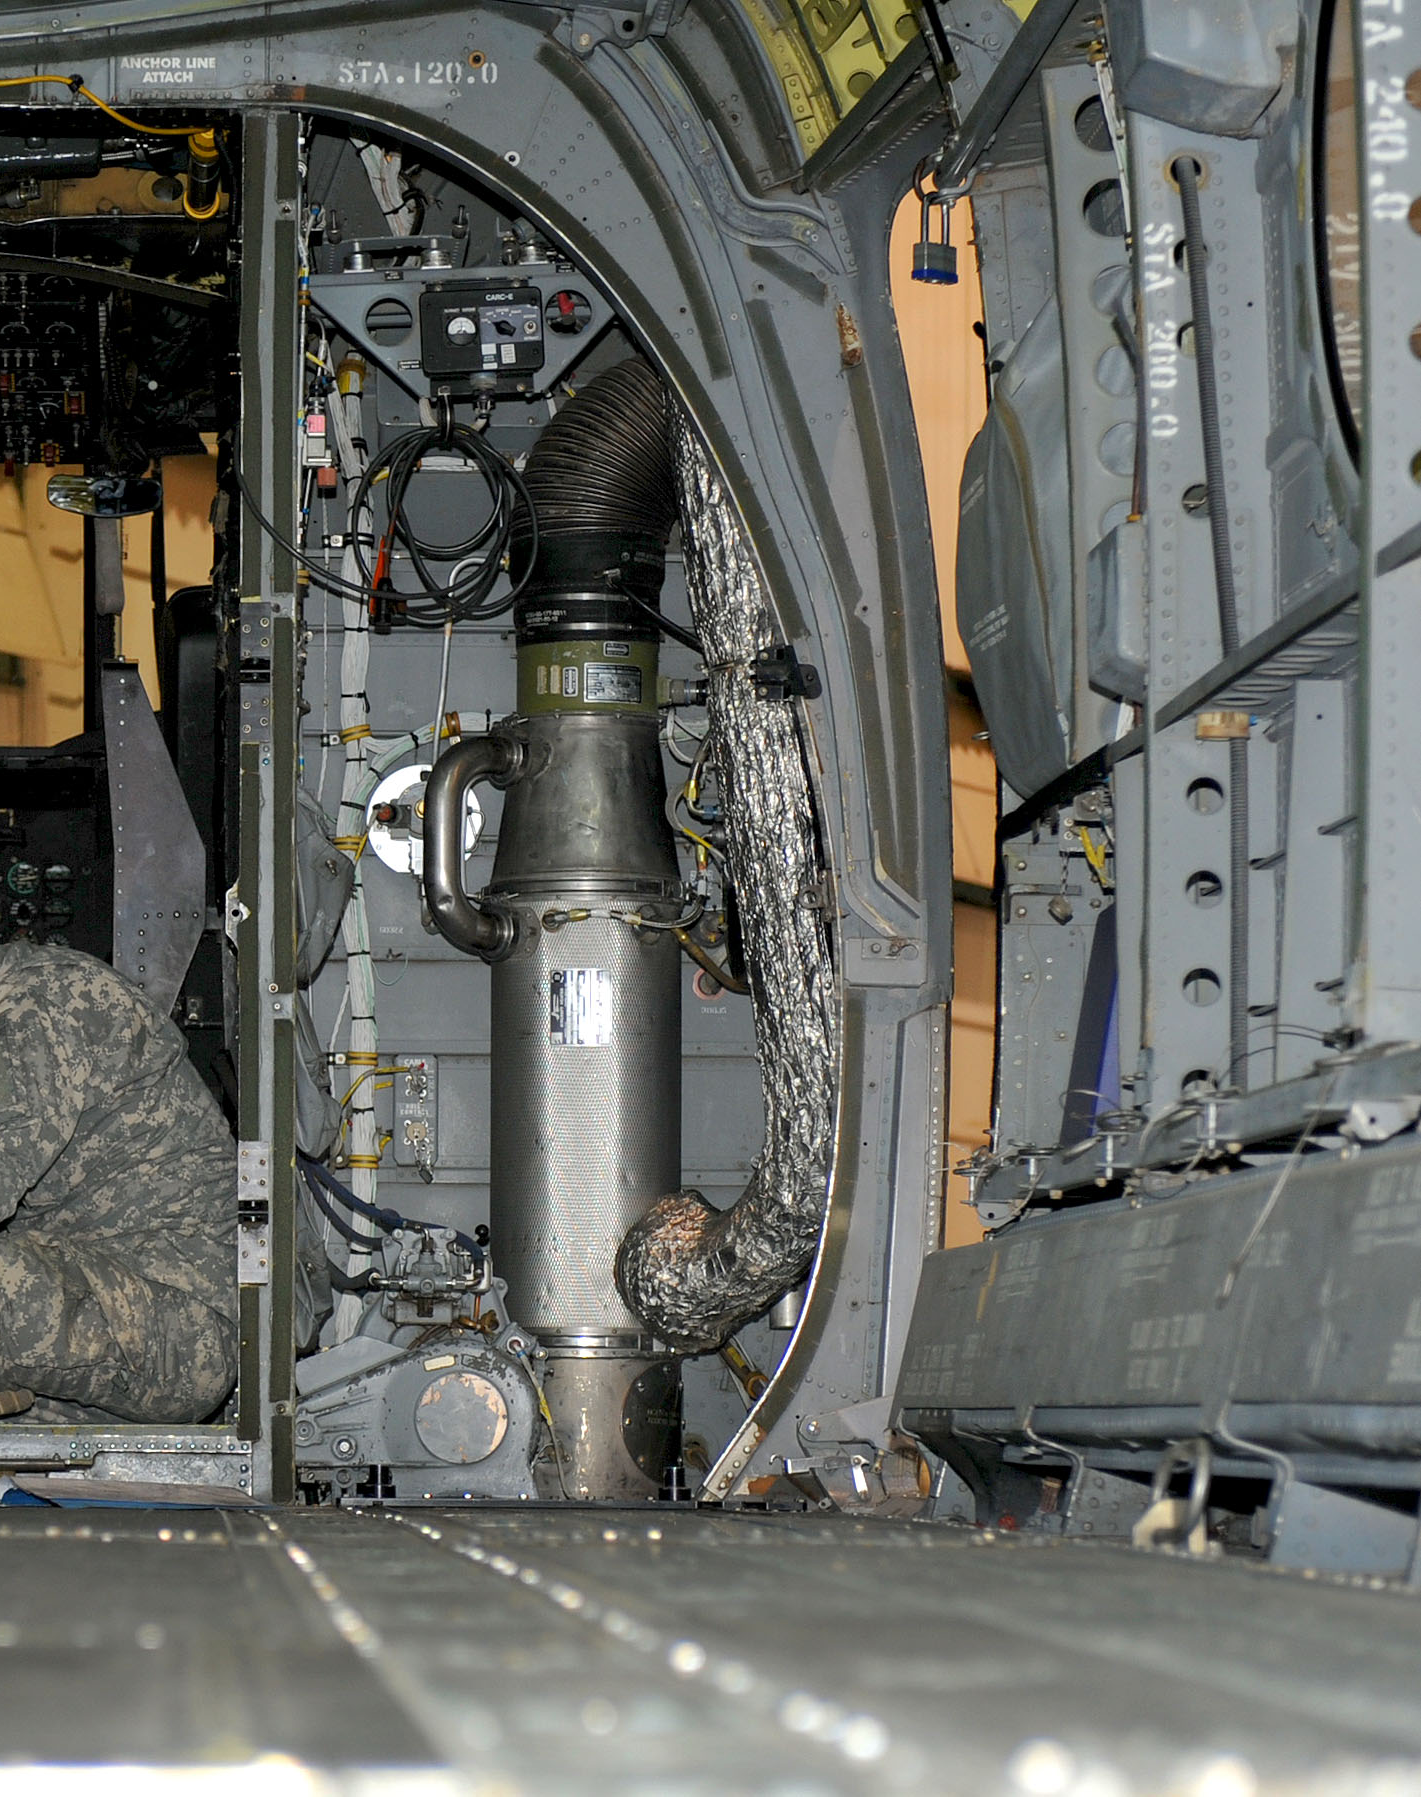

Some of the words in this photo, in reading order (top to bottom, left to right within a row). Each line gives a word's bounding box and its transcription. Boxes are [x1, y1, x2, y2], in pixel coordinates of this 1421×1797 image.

[120, 57, 181, 69] ANCHOR
[186, 57, 216, 69] LINE
[142, 71, 194, 83] ATTACH
[338, 61, 499, 84] STA.120.0
[1366, 76, 1410, 220] 240.0
[1143, 222, 1177, 293] STA
[1148, 320, 1179, 437] 200.0
